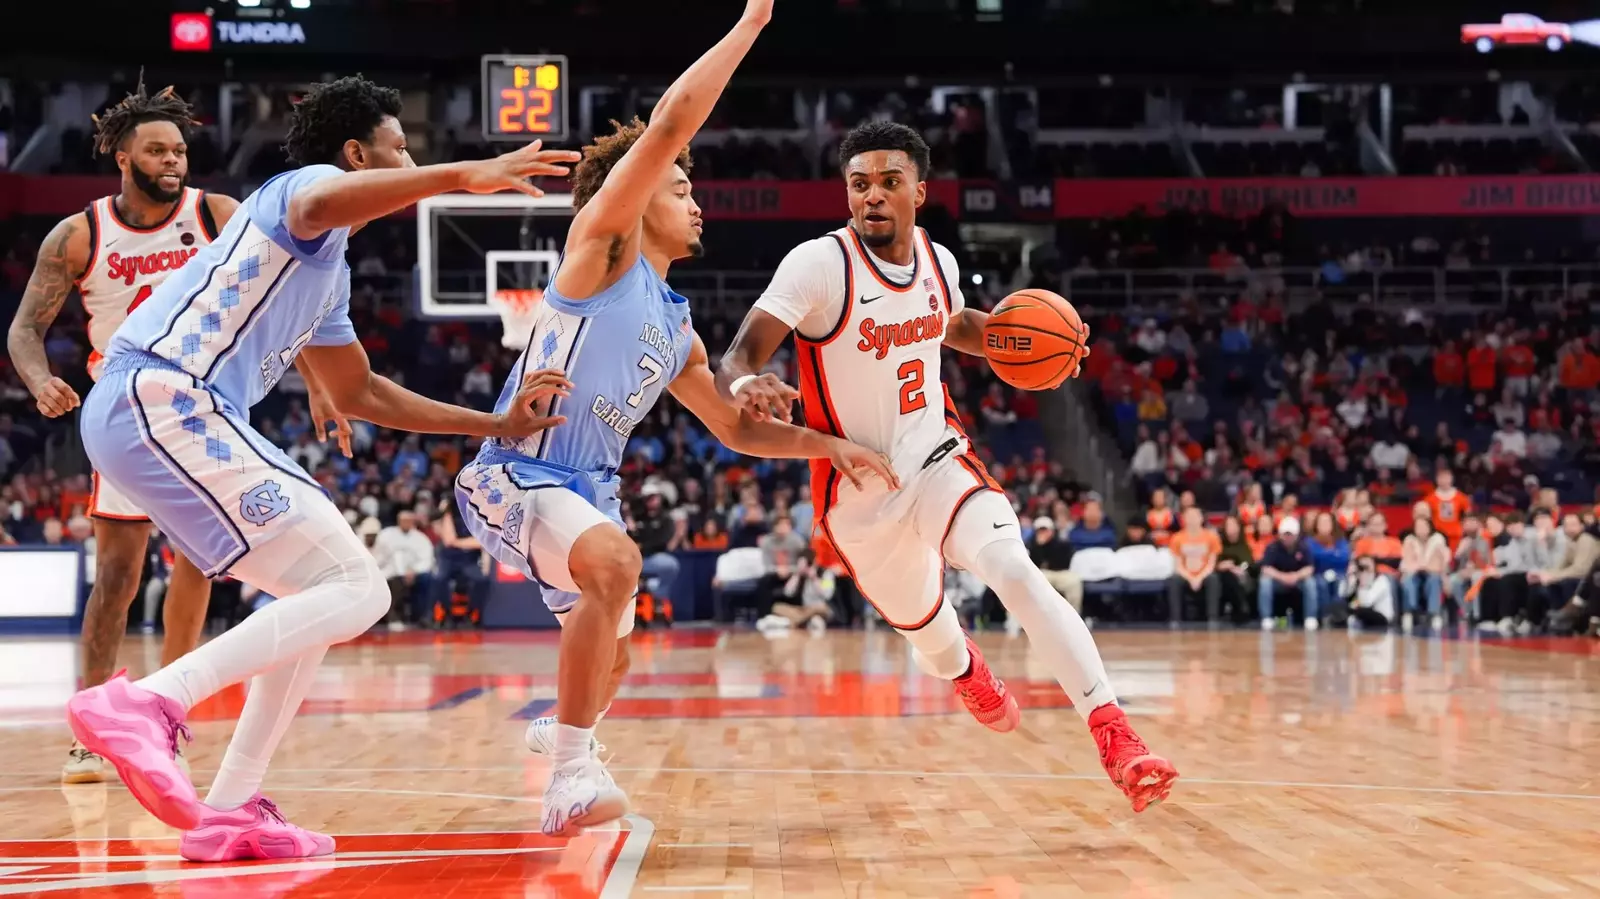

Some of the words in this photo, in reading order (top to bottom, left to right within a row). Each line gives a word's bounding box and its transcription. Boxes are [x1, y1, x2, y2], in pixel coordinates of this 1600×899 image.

[217, 21, 305, 43] TUNDRA
[499, 88, 553, 132] 22
[638, 322, 674, 369] NORTH
[857, 310, 944, 360] Syracuse
[625, 353, 664, 409] 7
[897, 358, 927, 416] 2
